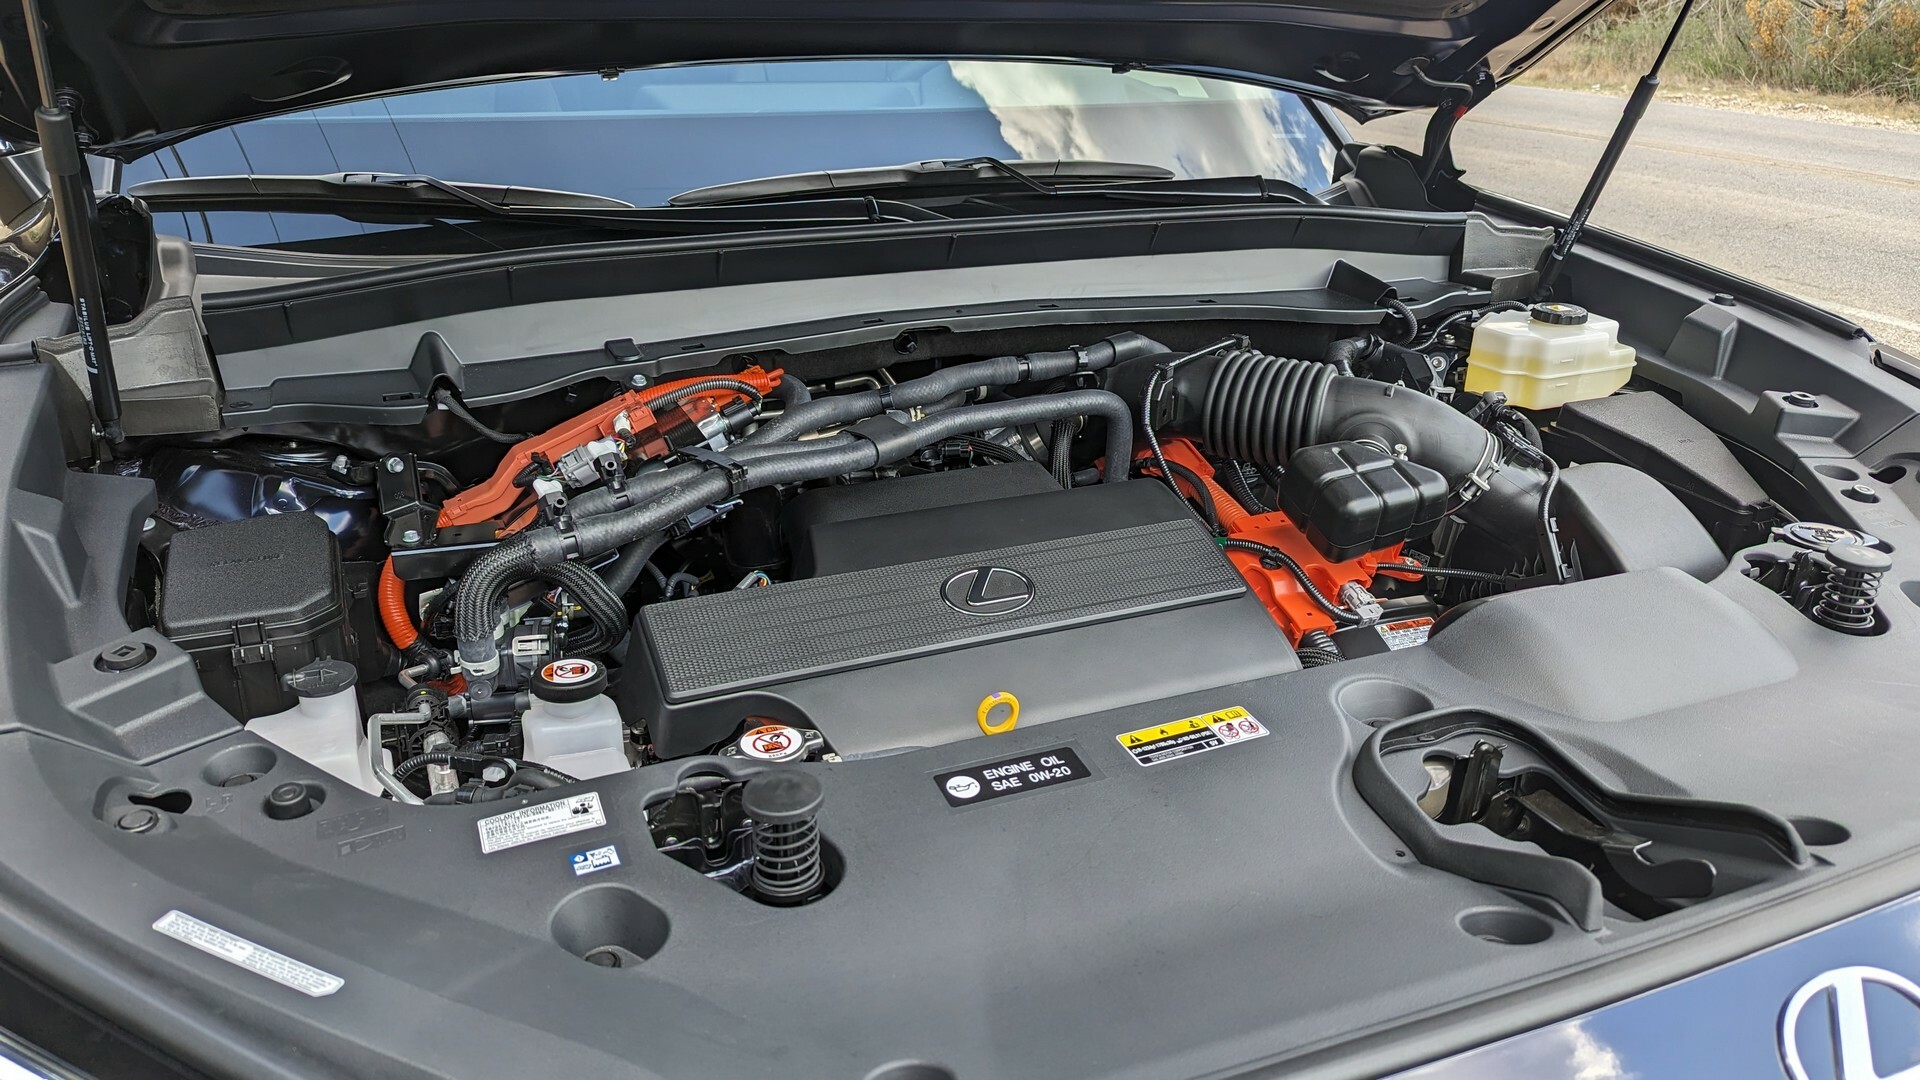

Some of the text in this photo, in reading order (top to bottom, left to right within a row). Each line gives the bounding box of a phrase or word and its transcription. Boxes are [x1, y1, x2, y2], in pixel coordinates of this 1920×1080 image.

[79, 297, 90, 331] STABILUS
[983, 756, 1065, 780] ENGINE OIL
[991, 767, 1071, 790] SAE 0W-20
[485, 801, 565, 826] COOLANT INFORMATION
